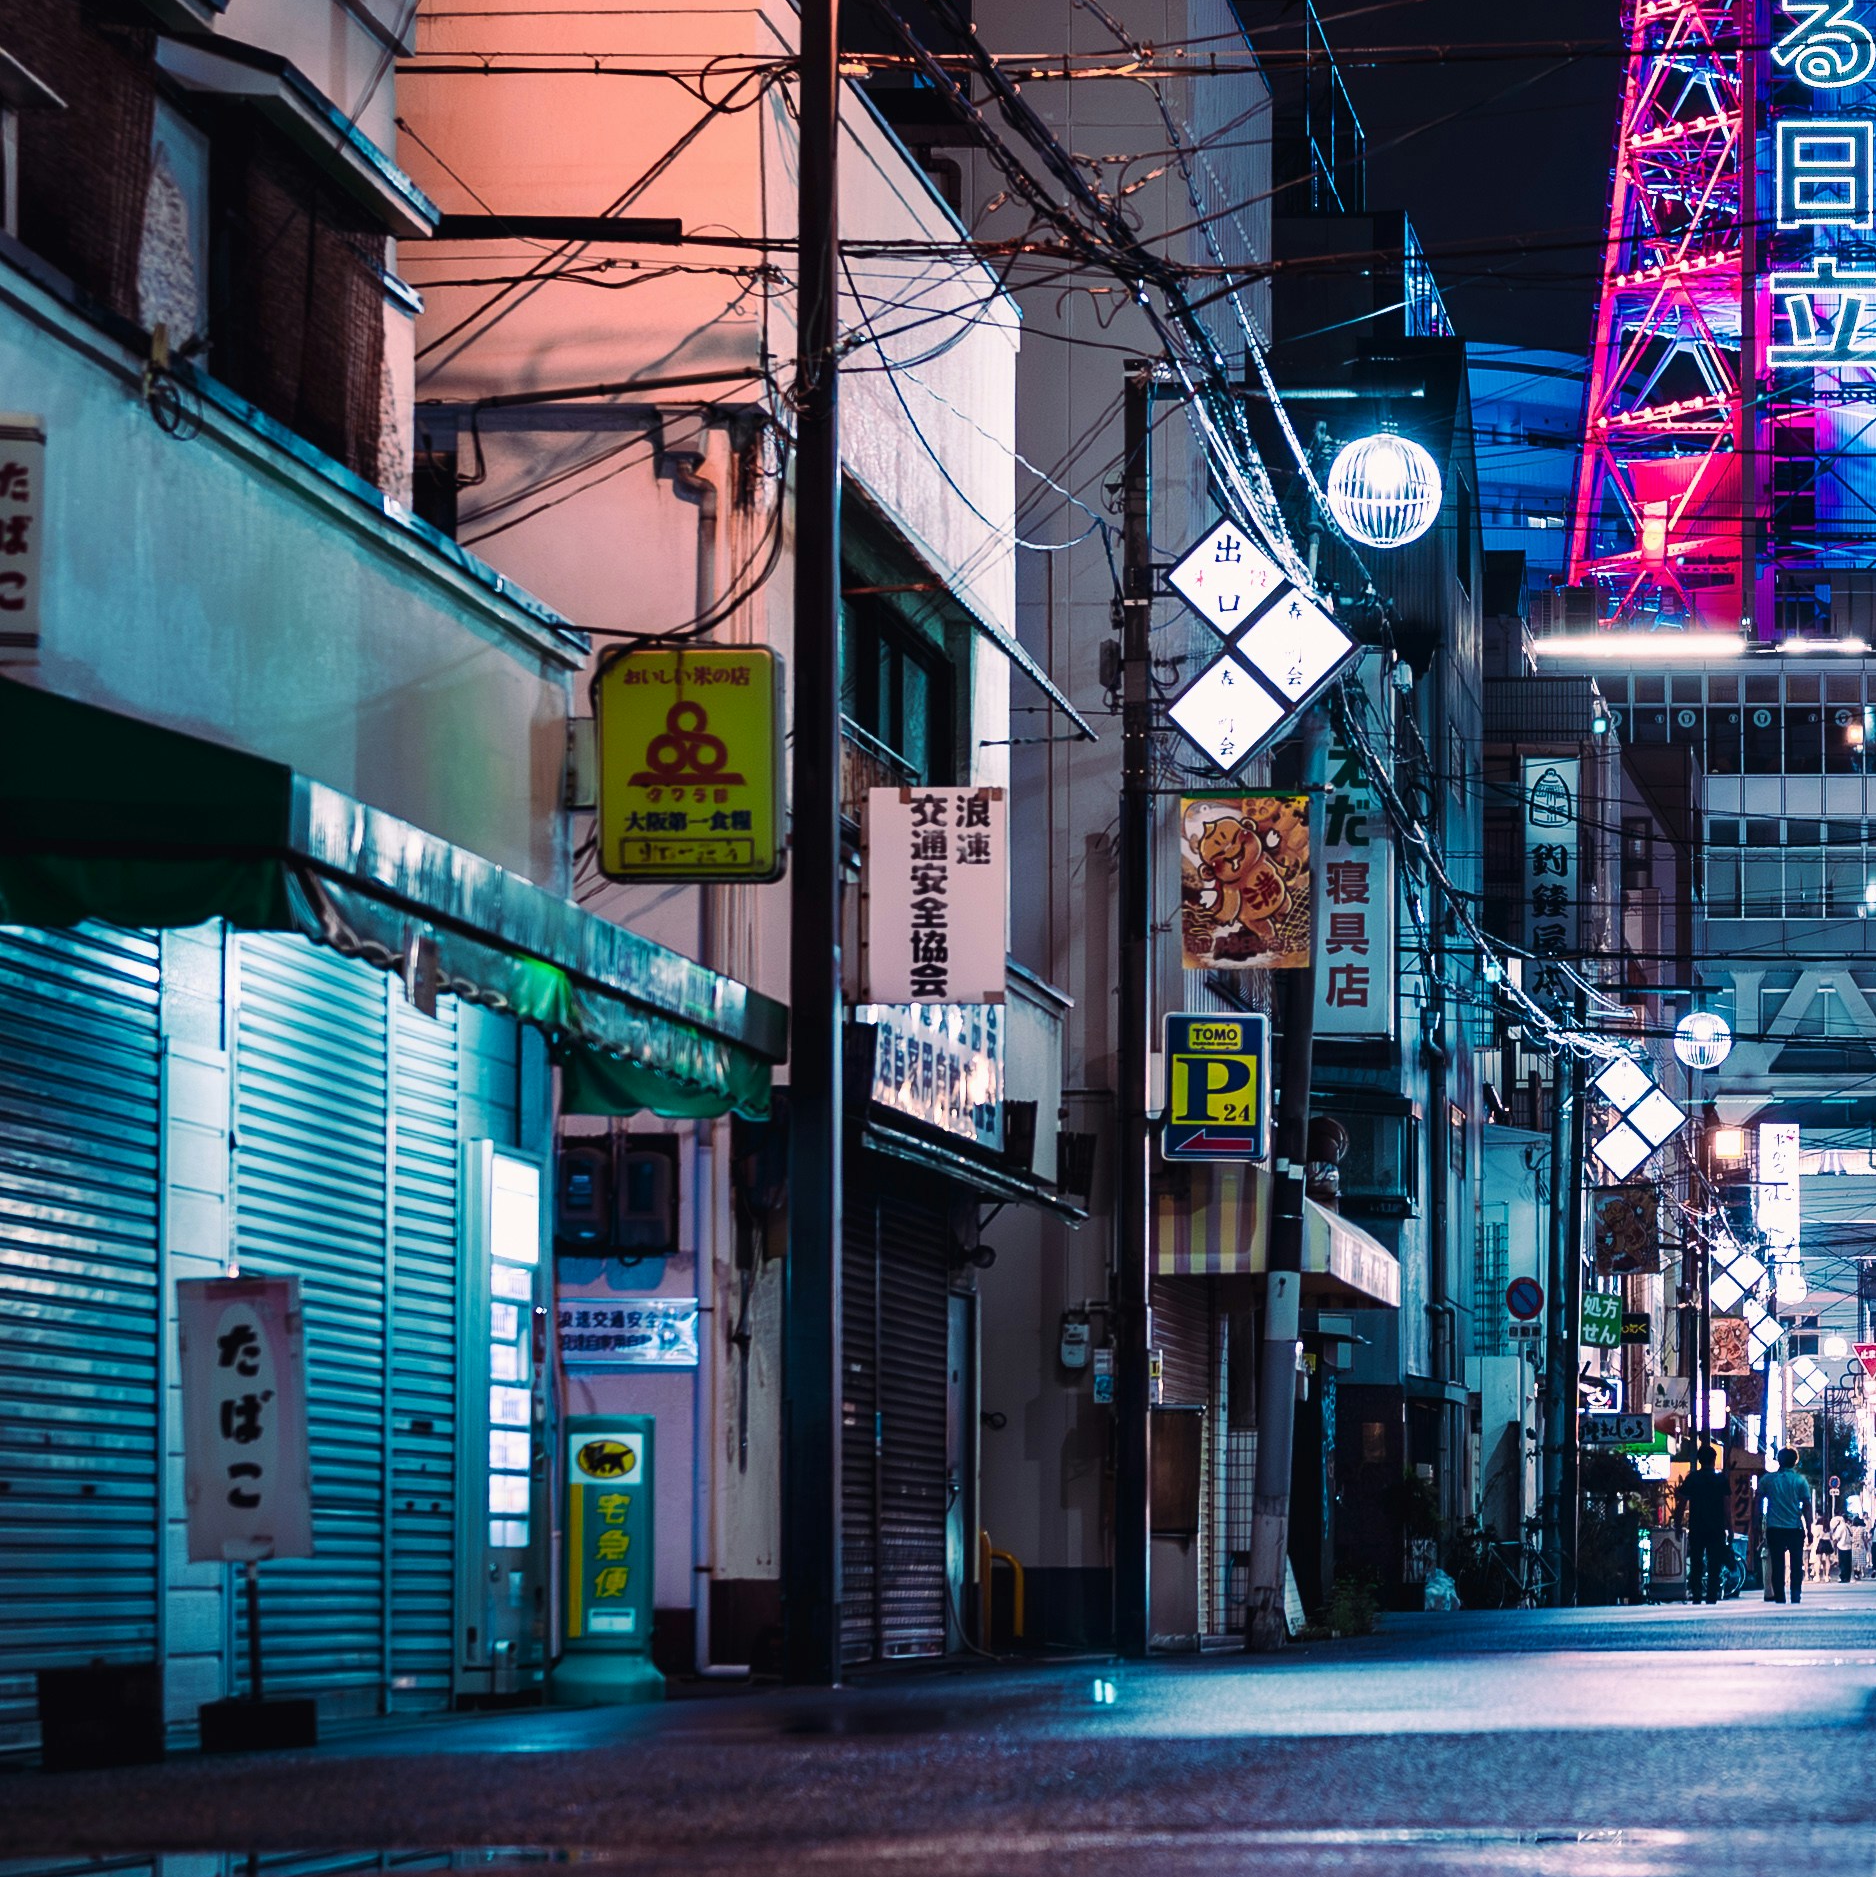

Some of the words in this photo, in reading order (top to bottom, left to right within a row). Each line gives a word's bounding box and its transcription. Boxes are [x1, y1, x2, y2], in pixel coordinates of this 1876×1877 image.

[623, 666, 751, 687] おいしい米の店
[625, 810, 752, 832] 大阪第一食糧
[956, 795, 991, 864] 浪速
[1325, 704, 1371, 1007] えだ寝具店
[910, 794, 948, 998] 交通安全協会
[1531, 842, 1569, 1004] 釣鐘屋本
[1193, 1028, 1238, 1041] TOMO
[1175, 1057, 1251, 1122] P
[1223, 1103, 1250, 1122] 24
[1583, 1294, 1620, 1320] 処方
[1582, 1323, 1617, 1345] せん
[216, 1324, 274, 1509] たばこ
[1654, 1399, 1689, 1410] とまり木
[593, 1493, 632, 1599] 宅急便
